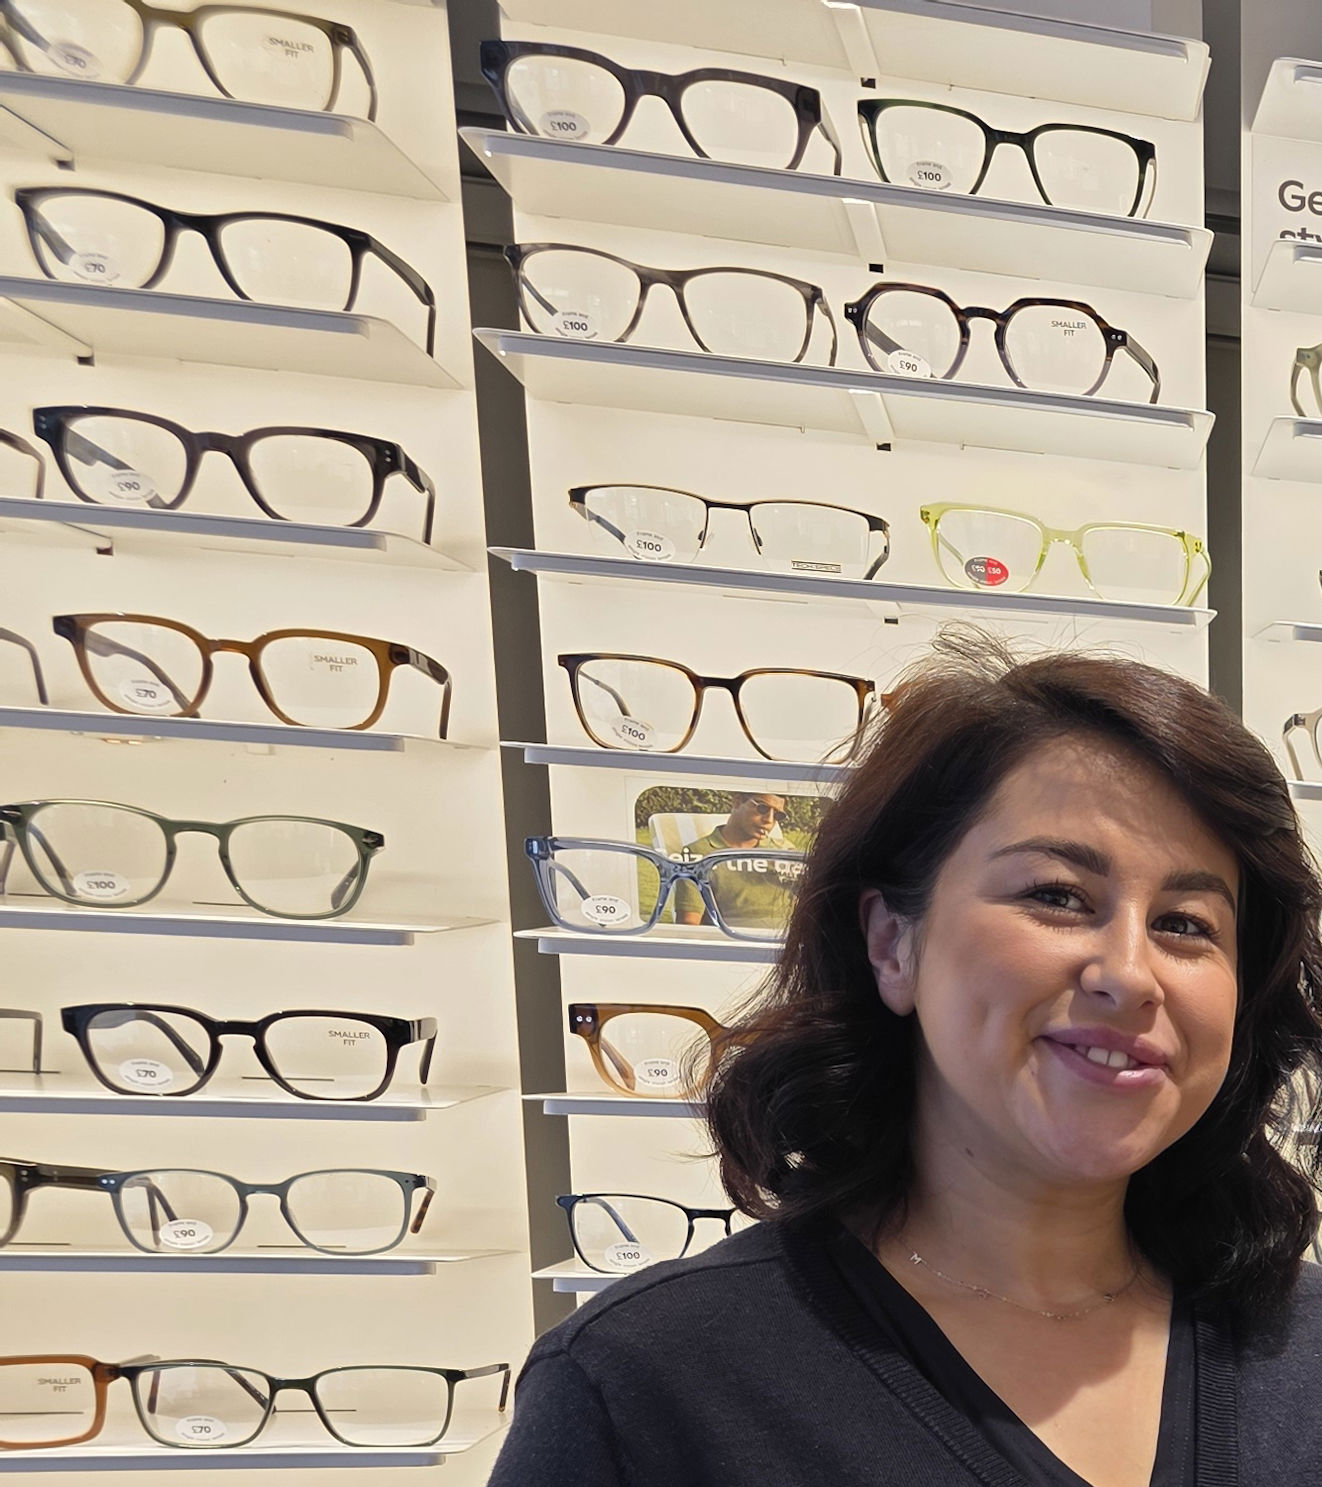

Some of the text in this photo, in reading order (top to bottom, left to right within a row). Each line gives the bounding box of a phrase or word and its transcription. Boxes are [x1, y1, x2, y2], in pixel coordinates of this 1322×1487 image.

[269, 37, 314, 52] SMALLER
[286, 49, 299, 59] FIT
[551, 121, 577, 131] £100
[917, 170, 942, 182] £100
[563, 321, 588, 331] £100
[1051, 321, 1087, 329] SMALLER
[1064, 329, 1075, 337] FIT
[900, 360, 918, 372] £90
[637, 540, 661, 552] £100
[314, 655, 357, 666] SMALLER
[330, 664, 342, 672] FIT
[595, 905, 616, 914] £90
[328, 1030, 370, 1039] SMALLER
[343, 1039, 356, 1047] FIT
[648, 1068, 668, 1077] £90
[191, 1425, 212, 1434] £70
